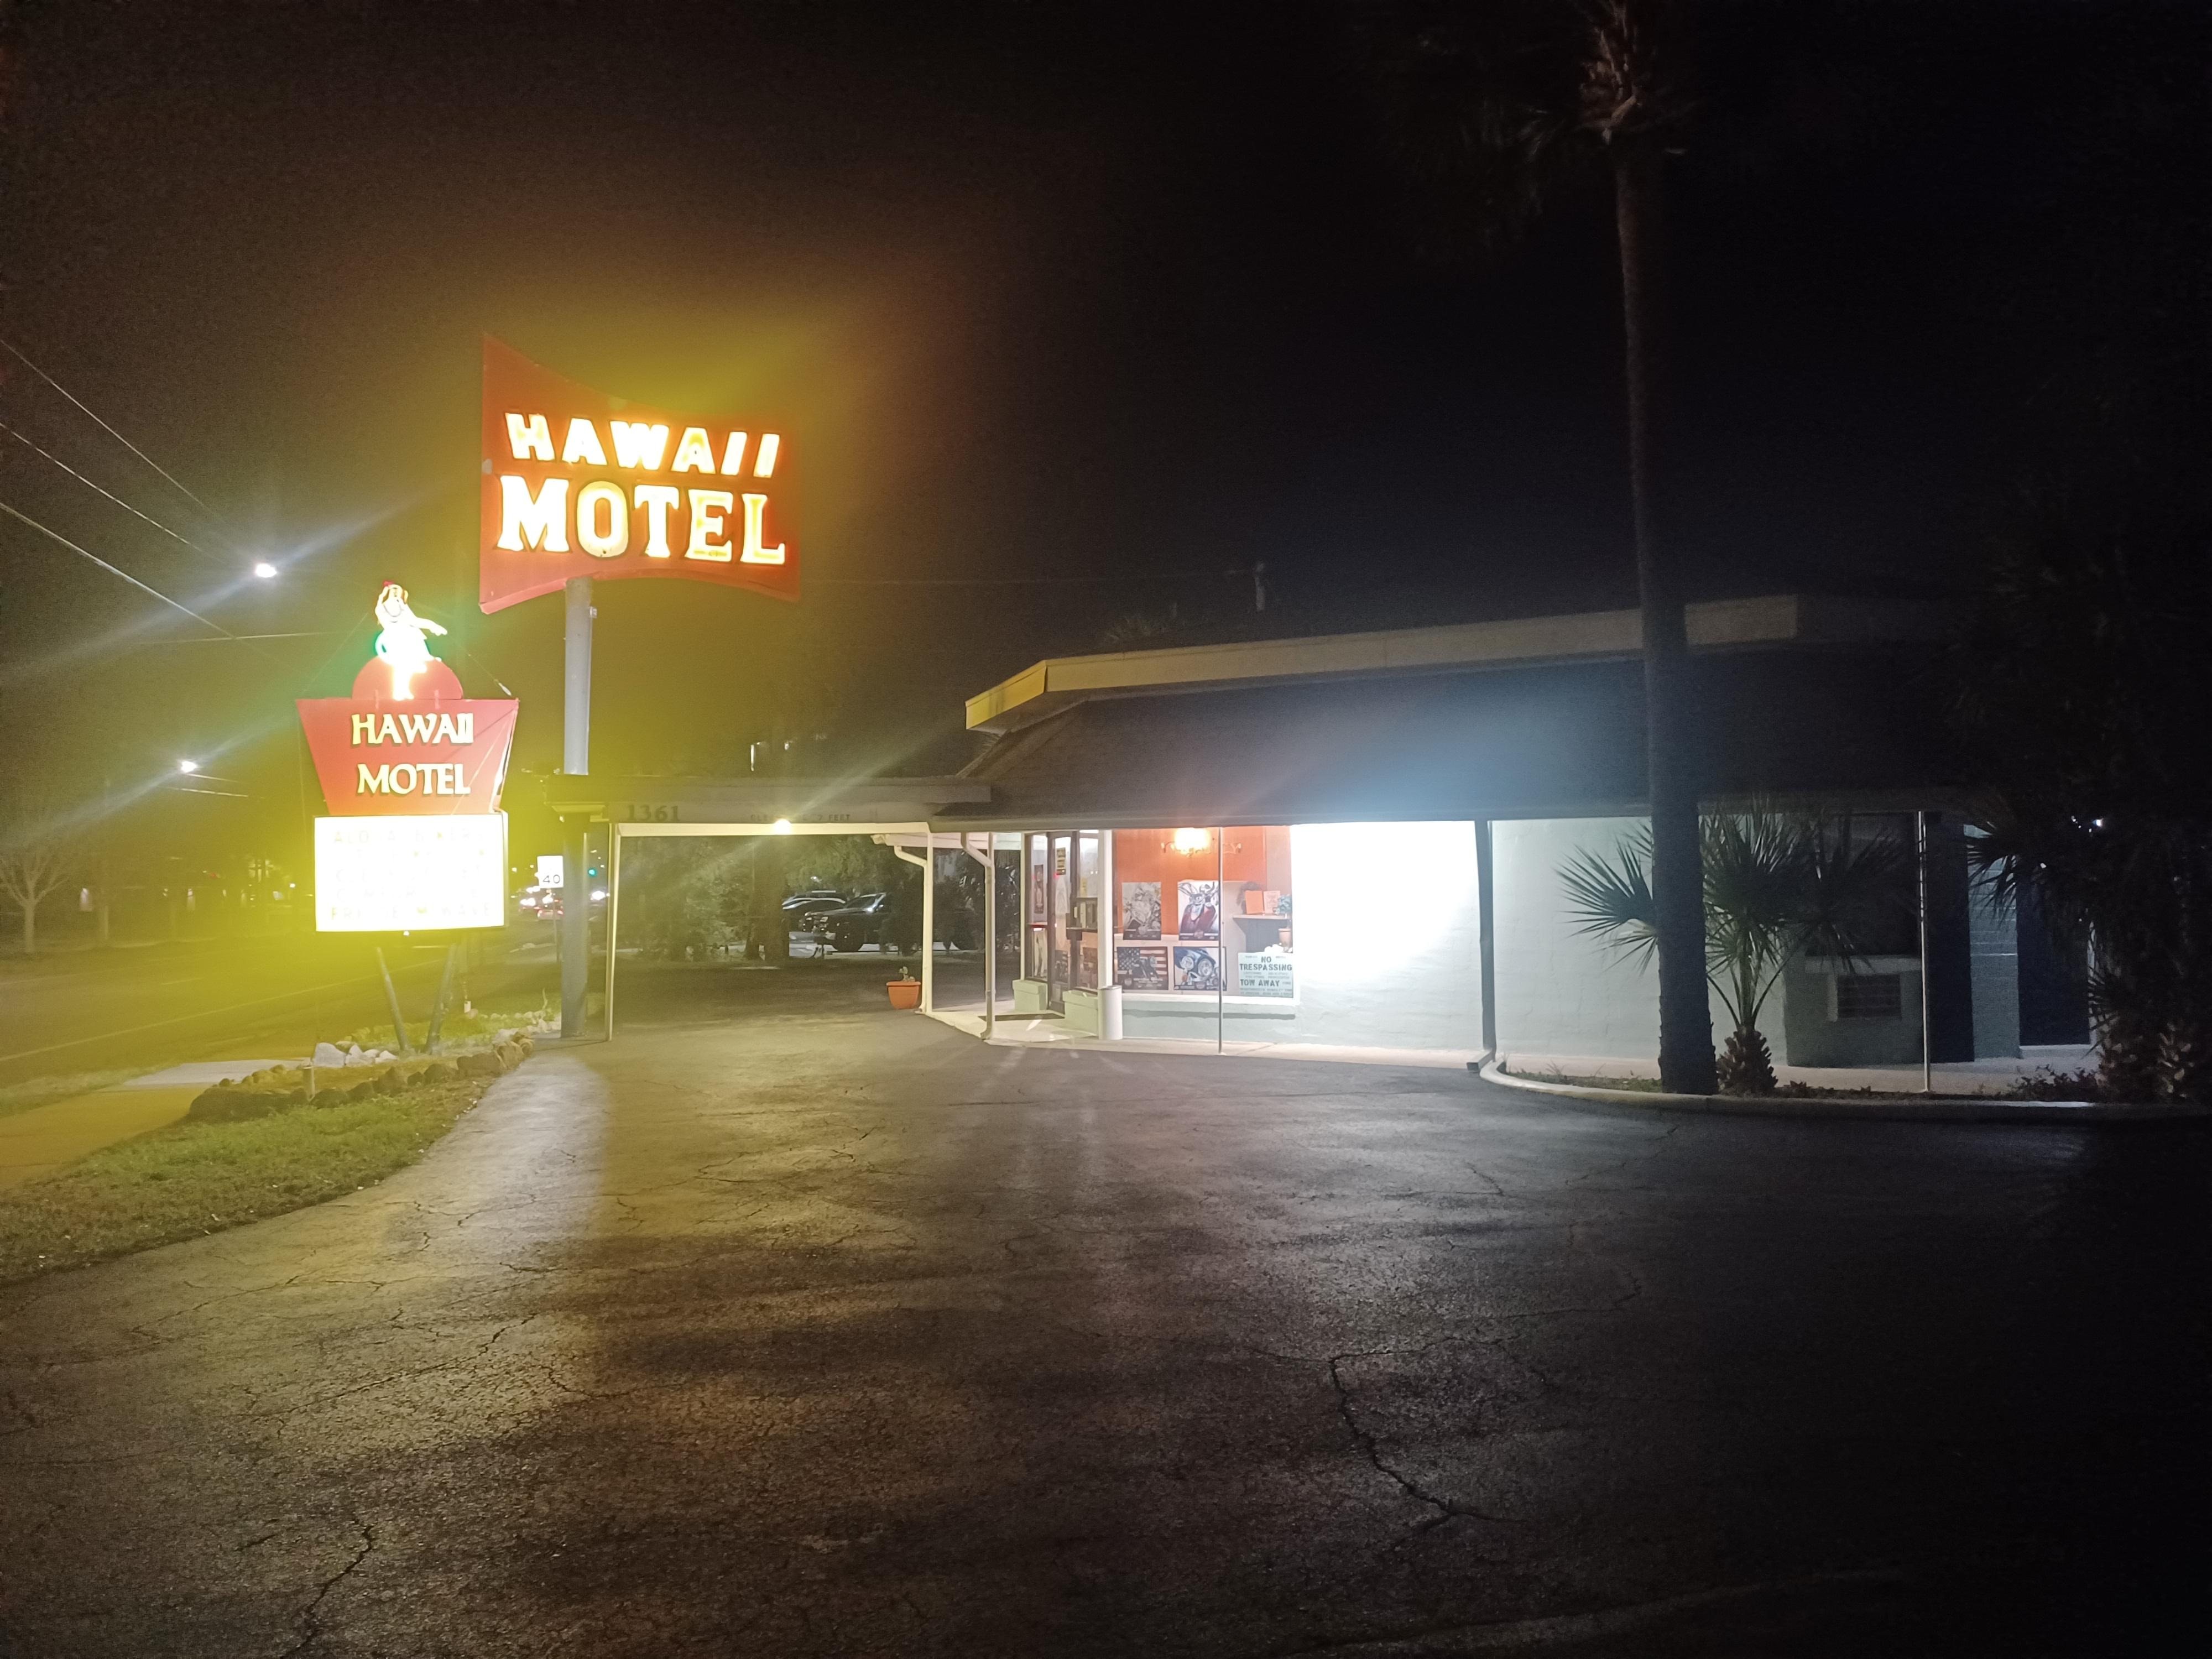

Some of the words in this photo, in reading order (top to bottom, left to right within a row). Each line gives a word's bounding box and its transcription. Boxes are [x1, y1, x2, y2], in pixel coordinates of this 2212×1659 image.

[505, 412, 780, 478] HAWAII
[497, 475, 785, 565] MOTEL
[351, 713, 474, 745] HAWAII
[357, 763, 471, 795] MOTEL
[627, 804, 681, 822] 1361
[542, 874, 560, 884] 40
